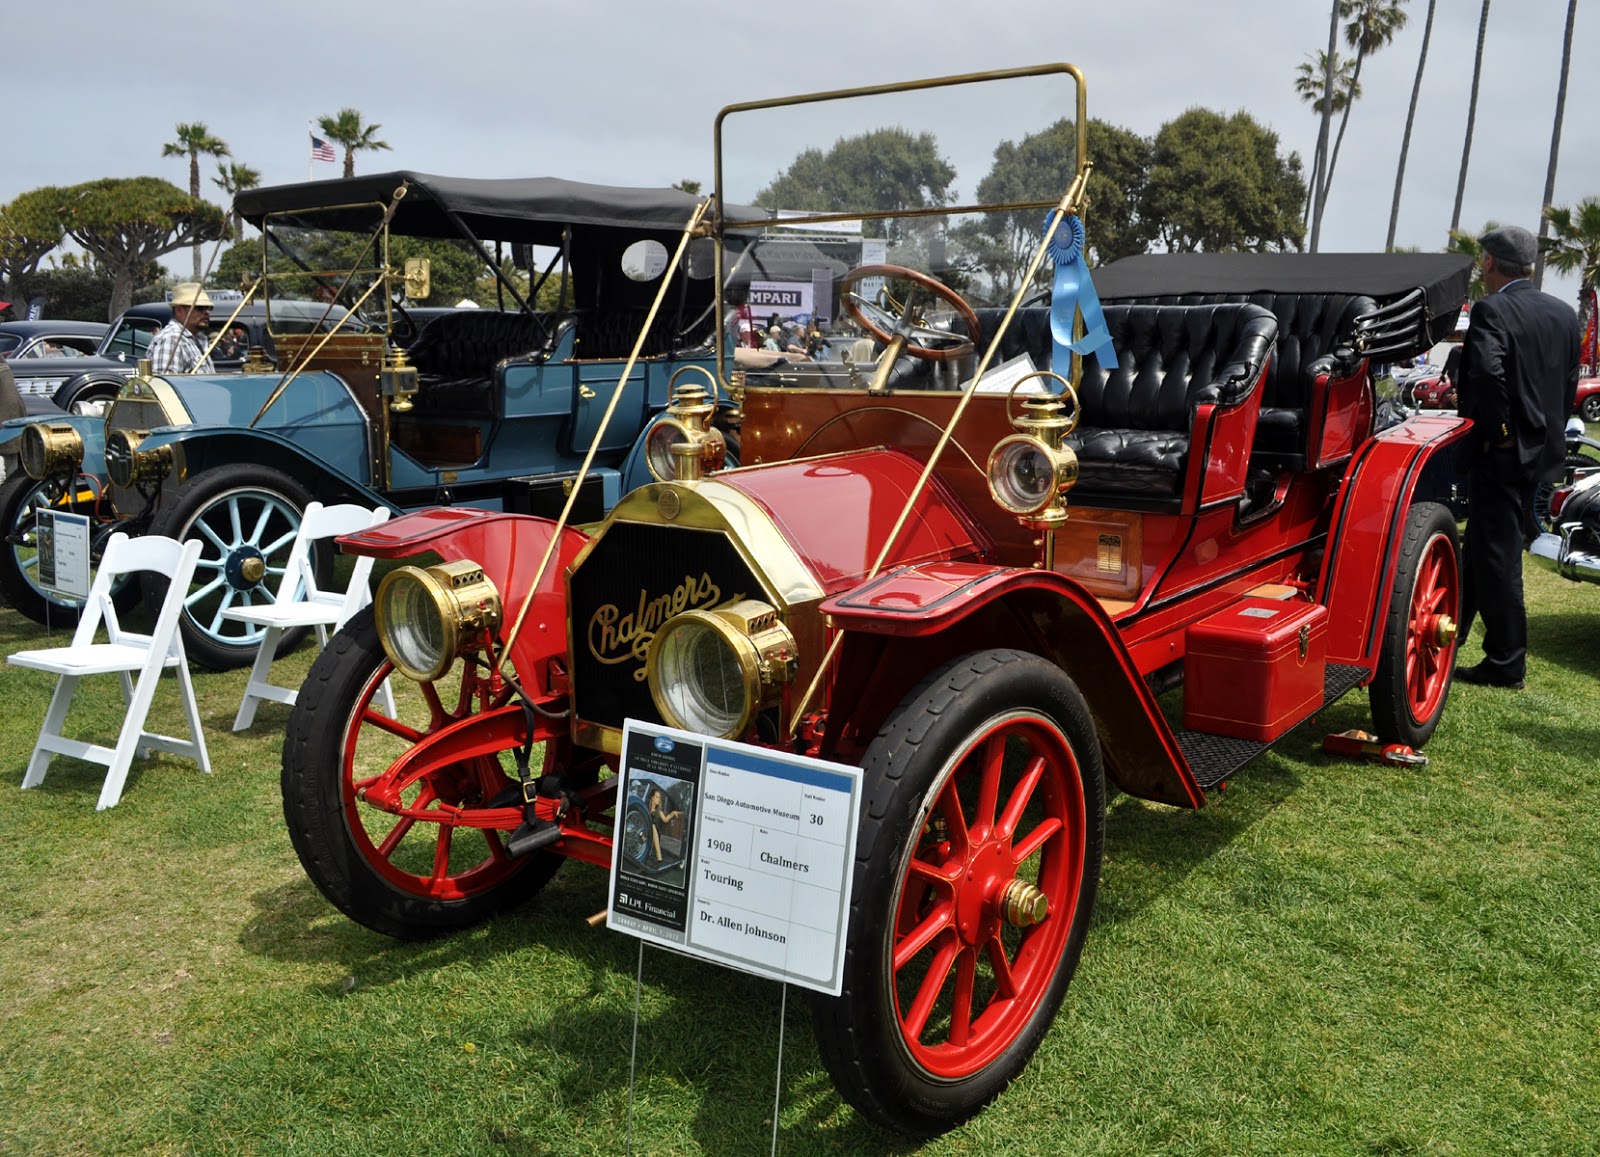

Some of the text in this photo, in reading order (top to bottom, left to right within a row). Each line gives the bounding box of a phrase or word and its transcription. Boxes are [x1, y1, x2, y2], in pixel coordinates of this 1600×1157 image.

[747, 291, 797, 304] MPARI
[705, 792, 800, 821] San Diego Automotive Museum
[809, 813, 824, 826] 30
[707, 838, 732, 853] 1908
[760, 851, 809, 873] Chalmers
[704, 869, 744, 891] Touring
[629, 898, 643, 909] LPL
[644, 902, 676, 919] Financial
[642, 924, 657, 935] APRIL
[700, 910, 715, 924] Dr.
[716, 916, 743, 932] Allen
[744, 923, 786, 944] Johnson
